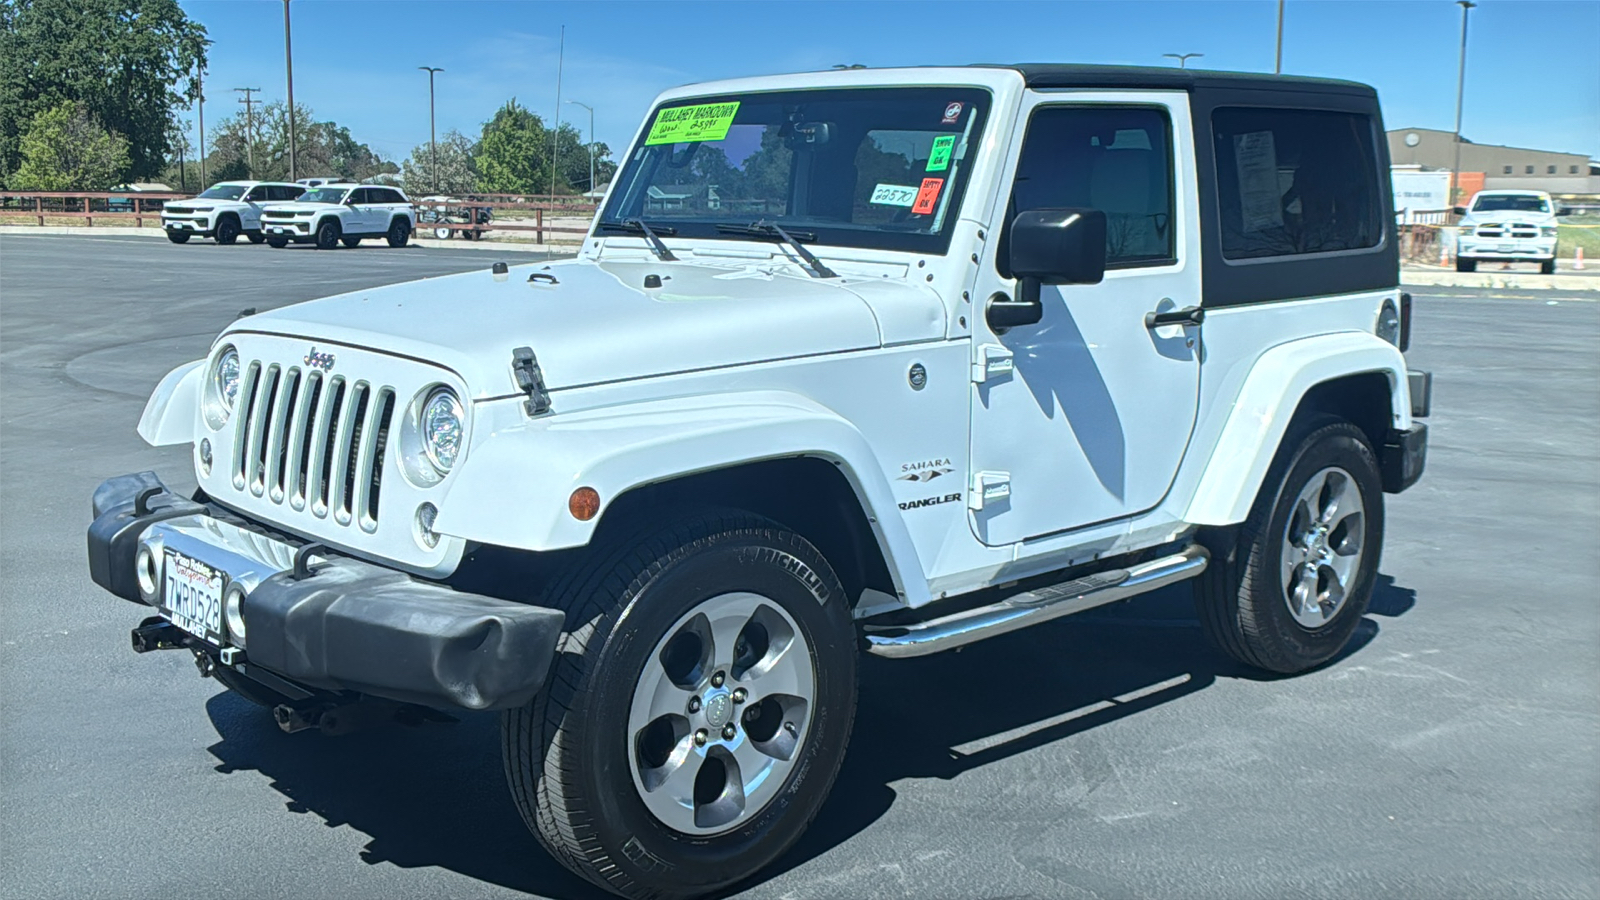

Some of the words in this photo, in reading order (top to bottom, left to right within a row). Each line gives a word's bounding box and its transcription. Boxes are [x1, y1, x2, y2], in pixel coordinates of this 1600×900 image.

[660, 108, 695, 123] MULLAHEY
[692, 105, 736, 119] MARKDOWN
[935, 139, 952, 148] SMOG
[933, 157, 944, 165] OK
[875, 189, 913, 202] 22570
[919, 199, 930, 208] OK
[304, 346, 336, 373] Jeep
[901, 458, 951, 472] SAHARA
[898, 493, 962, 510] RANGLER
[175, 552, 190, 567] Paso
[190, 558, 212, 577] Robles
[168, 575, 220, 632] 7WRD528
[171, 610, 207, 640] MULLAHEY
